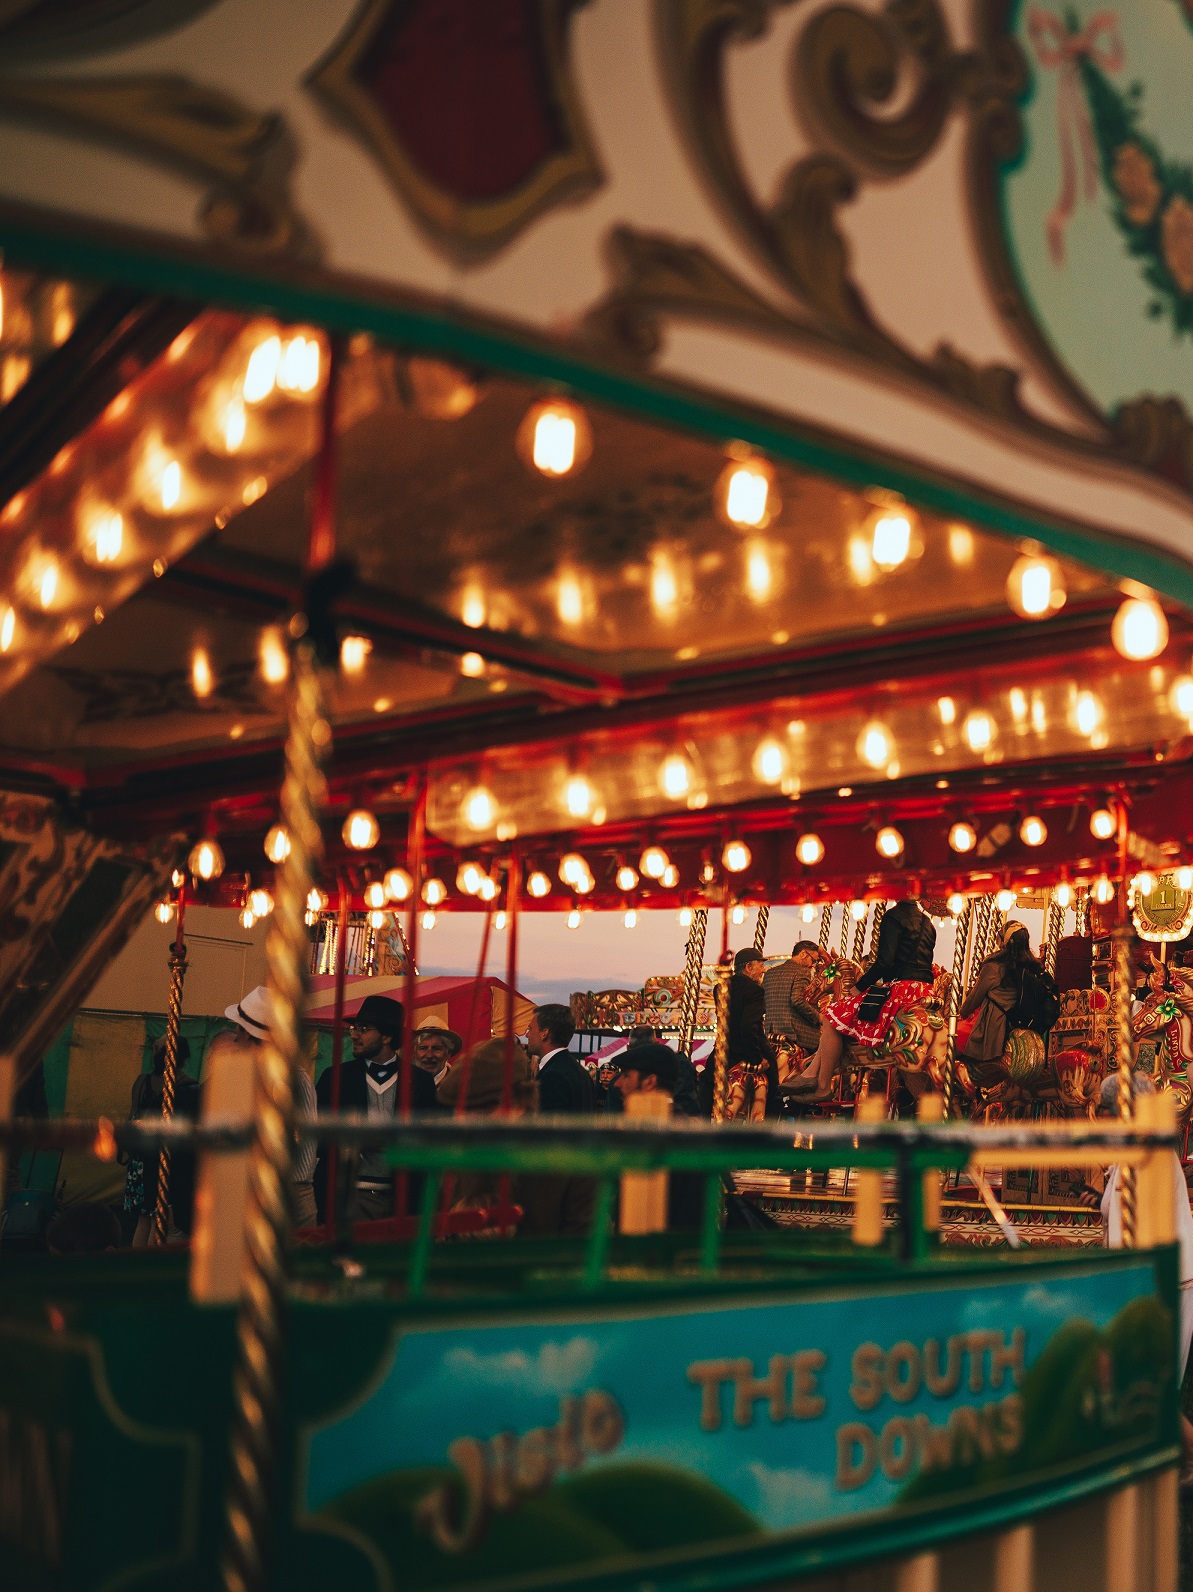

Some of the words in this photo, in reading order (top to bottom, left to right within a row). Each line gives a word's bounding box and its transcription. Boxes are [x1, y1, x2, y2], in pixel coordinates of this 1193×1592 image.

[1160, 890, 1167, 904] 1
[687, 1348, 826, 1431] THE
[851, 1326, 1026, 1411] SOUTH
[835, 1394, 1023, 1492] DOWNS
